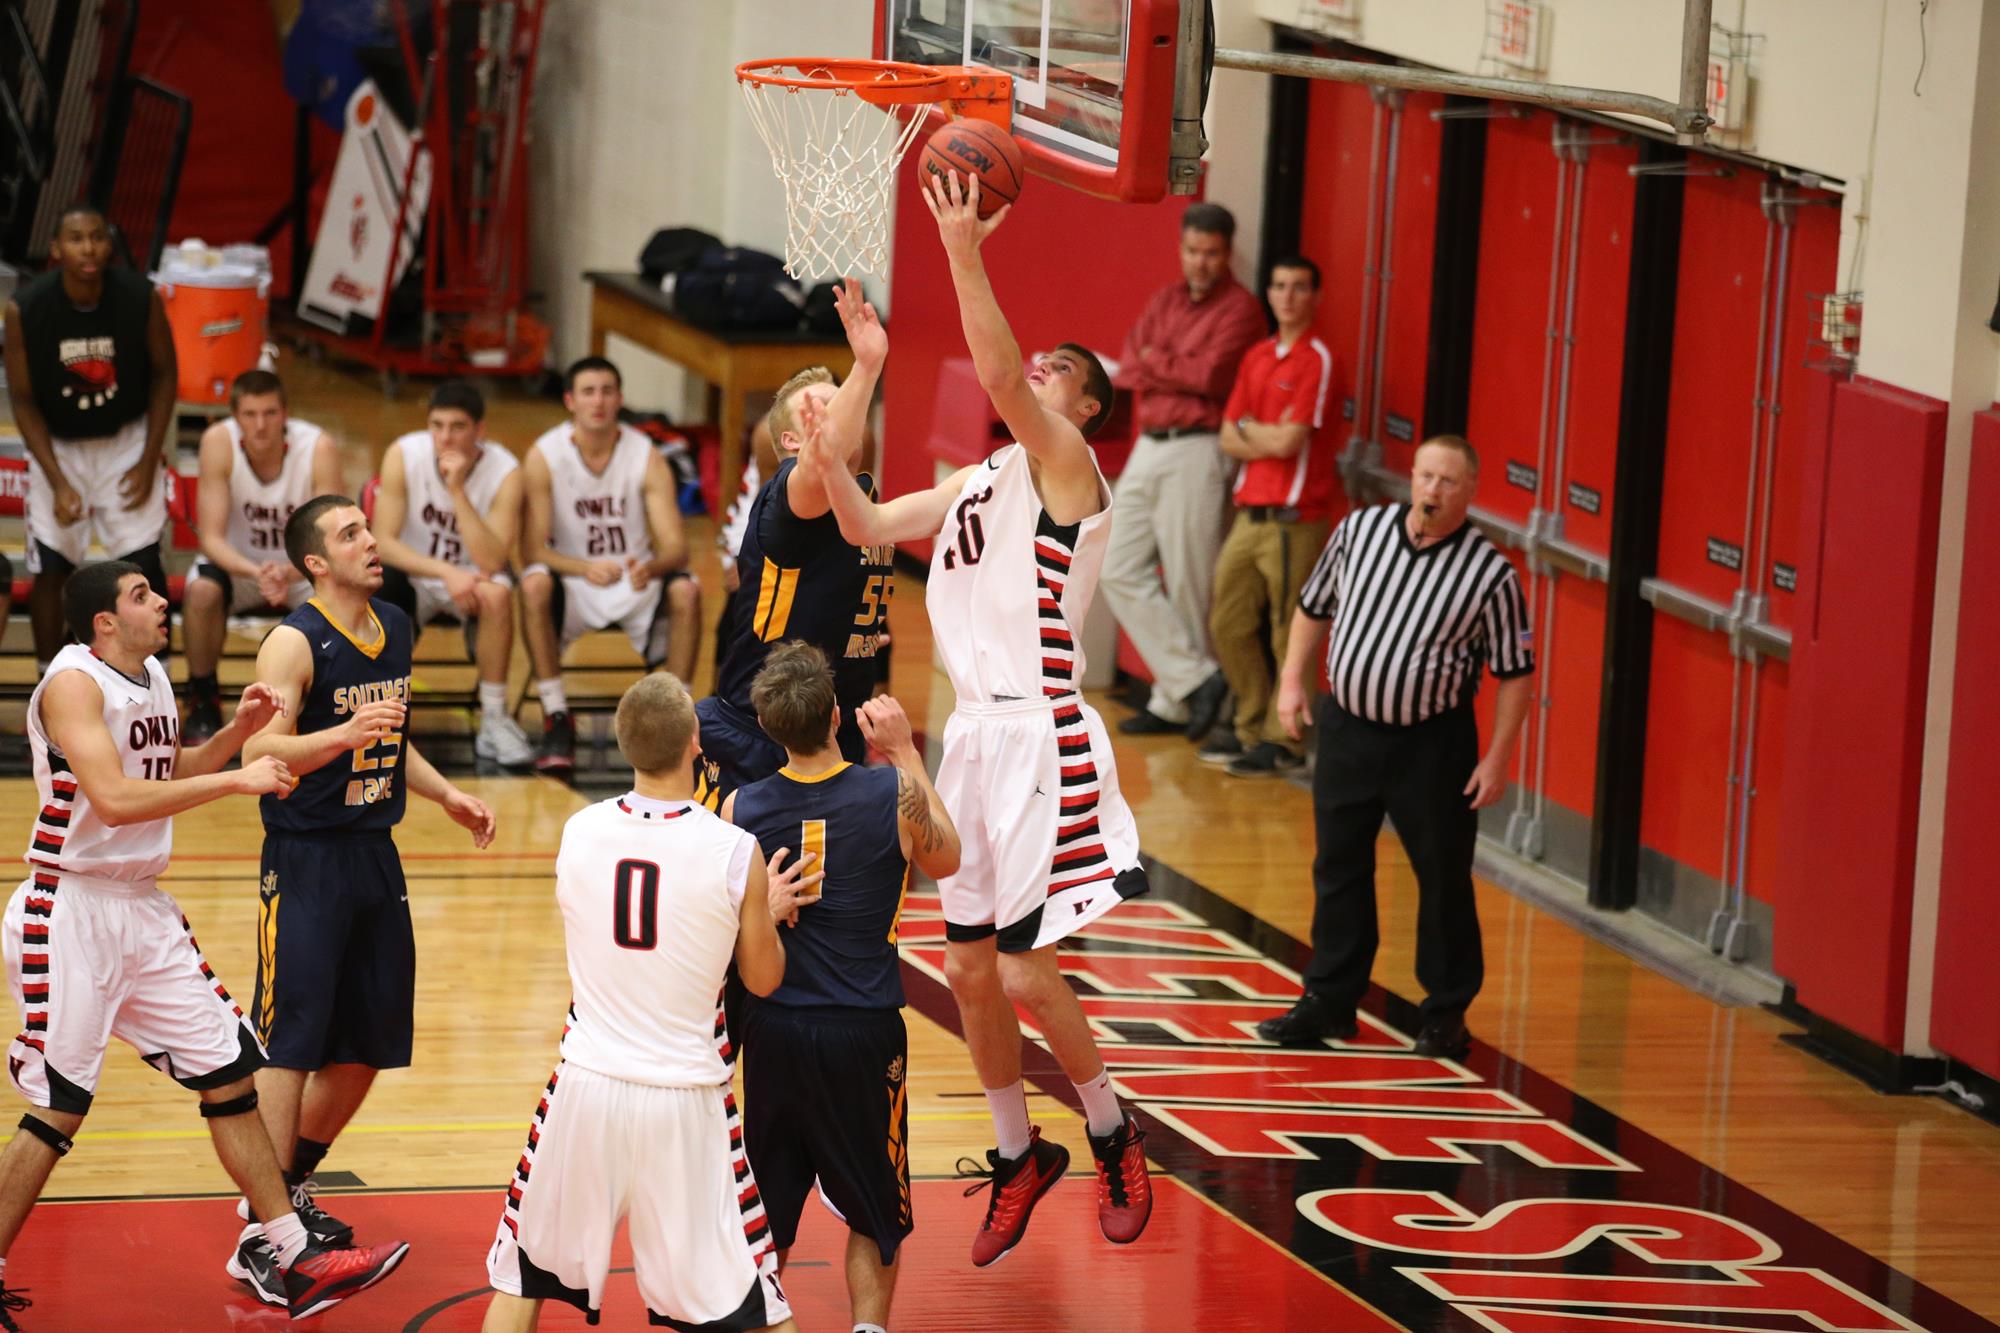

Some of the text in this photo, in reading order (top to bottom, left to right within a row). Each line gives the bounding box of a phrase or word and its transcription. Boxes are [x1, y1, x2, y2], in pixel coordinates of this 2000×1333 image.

[946, 136, 994, 174] NCAA
[421, 502, 459, 533] OWL
[588, 524, 627, 556] 20
[333, 675, 411, 715] SOUTHER
[800, 819, 826, 900] 1
[613, 857, 661, 951] 0
[1296, 1187, 1932, 1333] ST
